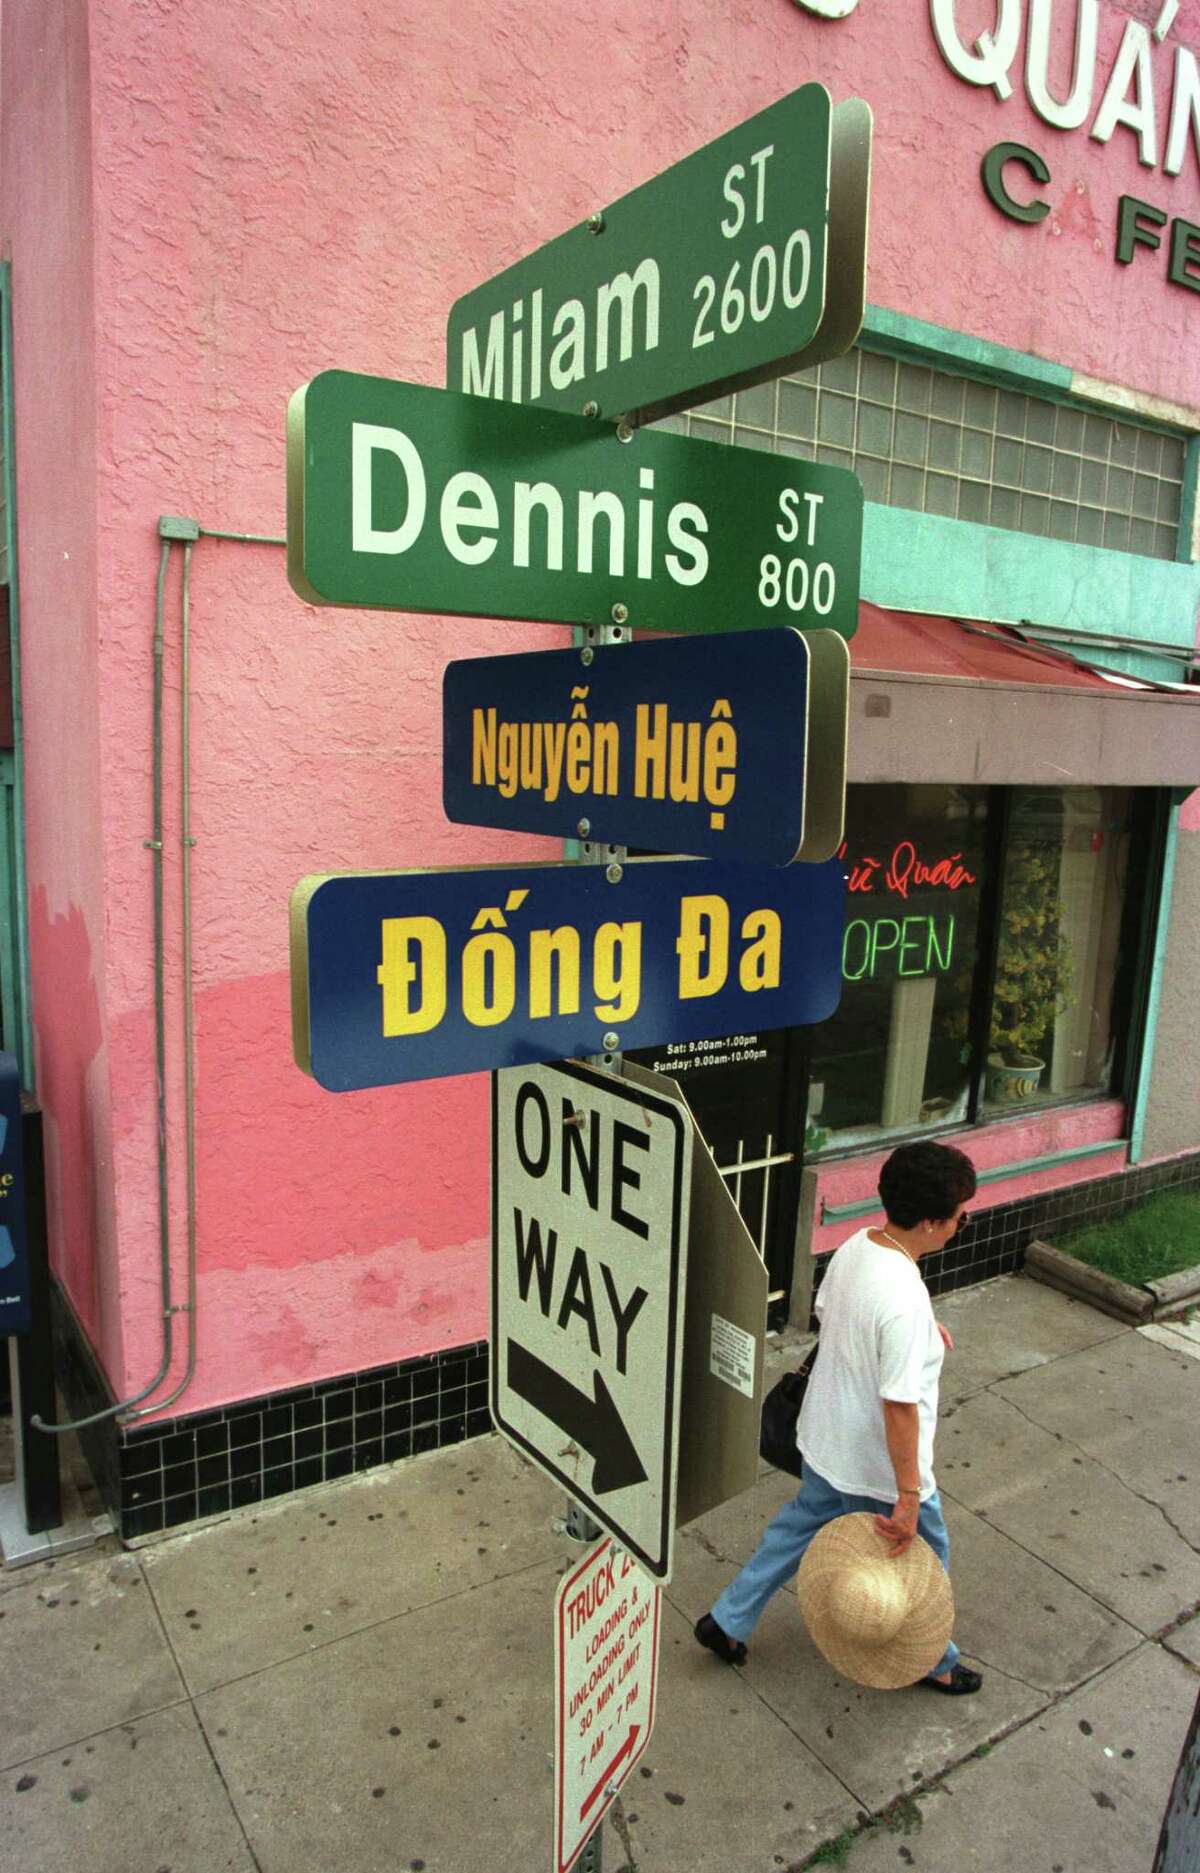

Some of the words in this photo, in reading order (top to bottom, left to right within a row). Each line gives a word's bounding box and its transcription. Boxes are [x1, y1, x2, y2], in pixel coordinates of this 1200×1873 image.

[720, 145, 774, 239] ST
[462, 257, 660, 404] Milam
[692, 229, 811, 349] 2600
[352, 422, 709, 586] Dennis
[776, 488, 824, 546] ST
[758, 554, 836, 615] 800
[472, 685, 619, 802] Nguyễn
[634, 698, 737, 830] Huệ
[377, 889, 642, 1037] Đống
[676, 894, 782, 1000] Đa
[842, 913, 954, 980] OPEN
[653, 1059, 692, 1072] Sunday:
[694, 1049, 767, 1068] 9.00am-10.00pm
[667, 1043, 687, 1055] Sat:
[688, 1035, 758, 1053] 9.00am-1.00pm
[515, 1081, 650, 1241] ONE
[514, 1206, 649, 1376] WAY
[567, 1553, 615, 1639] TRUCK
[586, 1598, 627, 1663] LOADING
[569, 1634, 624, 1718] UNLOADING
[629, 1599, 651, 1639] ONLY
[580, 1708, 593, 1737] 30
[597, 1677, 614, 1714] MIN
[618, 1642, 640, 1685] LIMIT
[590, 1730, 604, 1763] AM
[626, 1682, 638, 1712] PM
